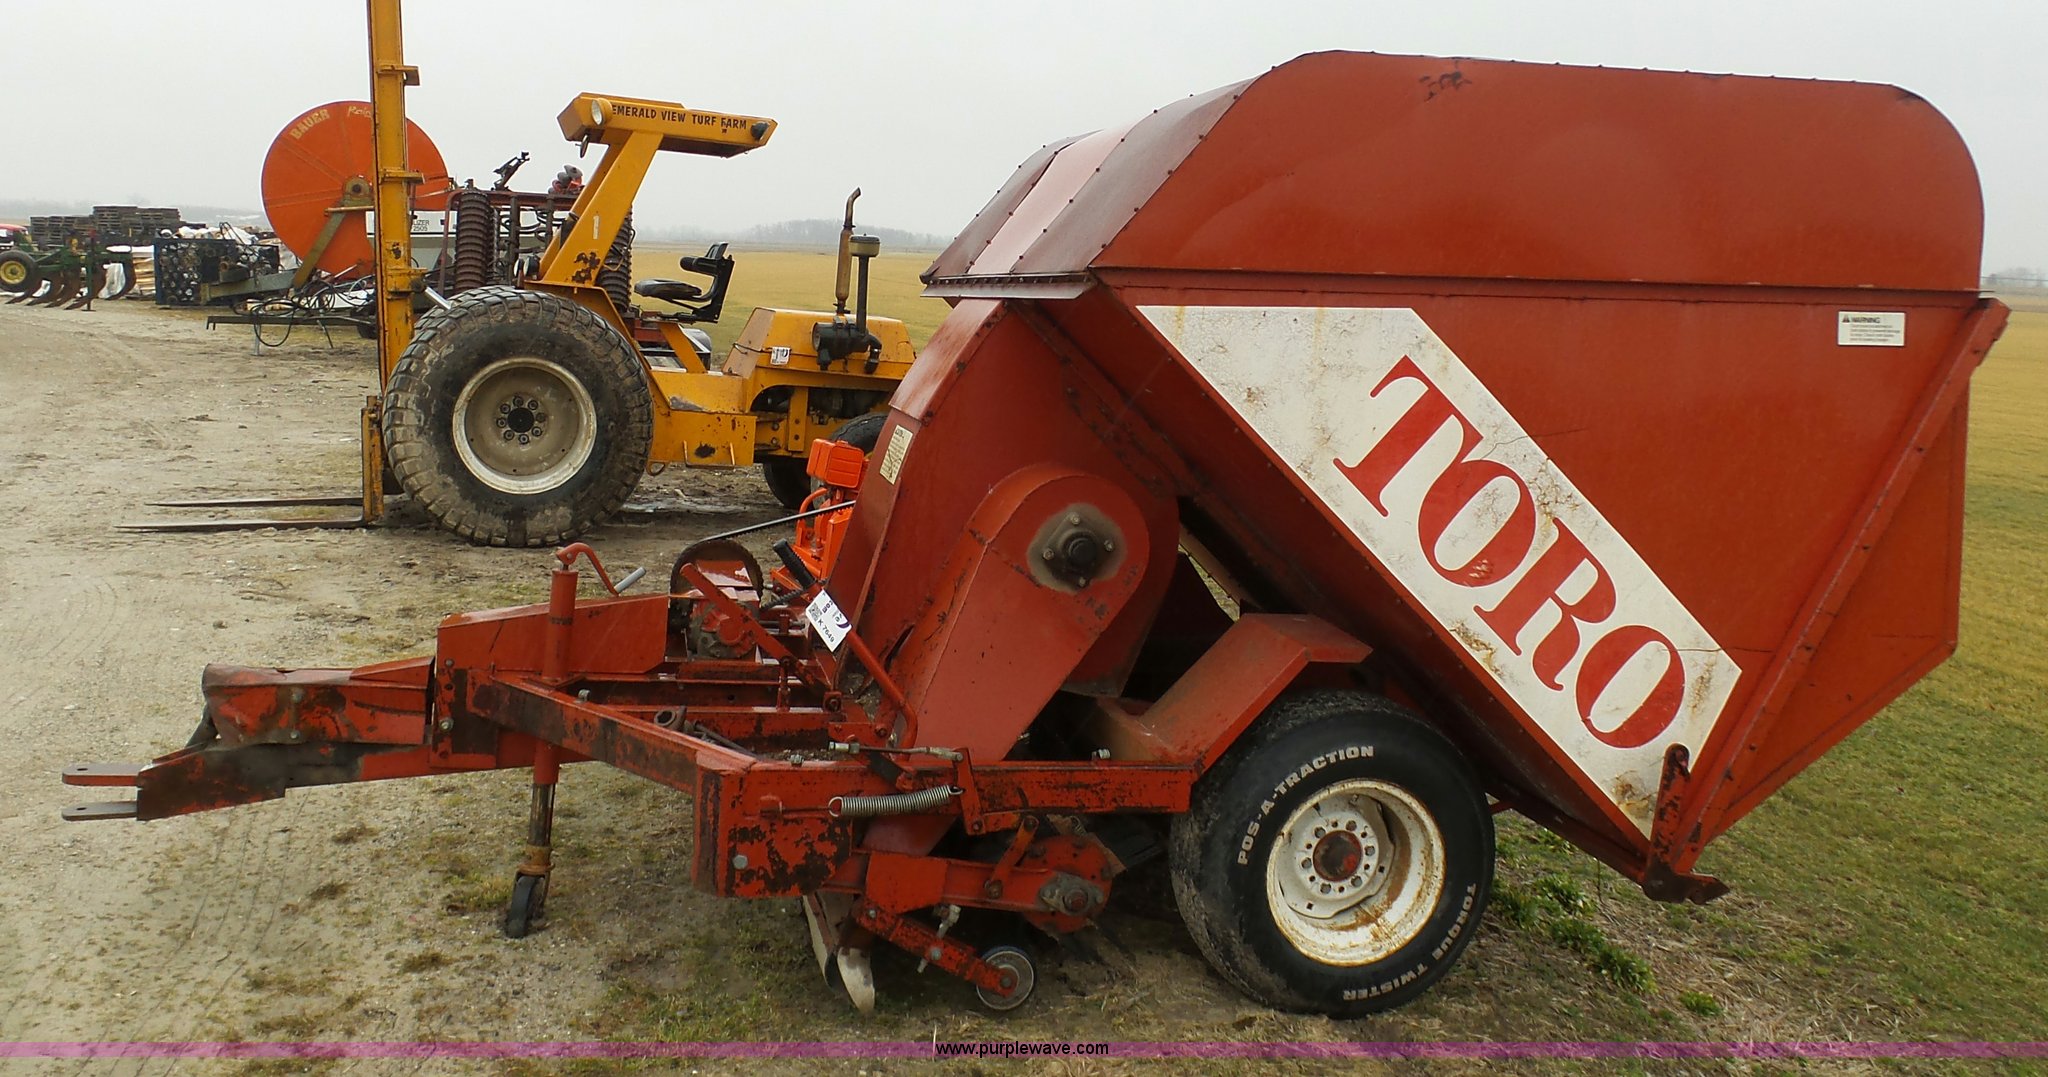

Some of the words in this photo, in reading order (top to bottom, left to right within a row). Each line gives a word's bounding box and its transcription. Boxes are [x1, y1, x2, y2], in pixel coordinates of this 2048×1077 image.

[289, 108, 331, 140] BAUER
[612, 104, 657, 120] EMERALD
[661, 111, 686, 123] VIEW
[692, 114, 717, 126] TURF
[721, 117, 747, 130] FARM
[1332, 354, 1687, 751] TORO
[1237, 745, 1375, 866] POS-A-TRACTION
[1432, 882, 1478, 961] TORQUE
[1342, 962, 1429, 1001] TWISTER
